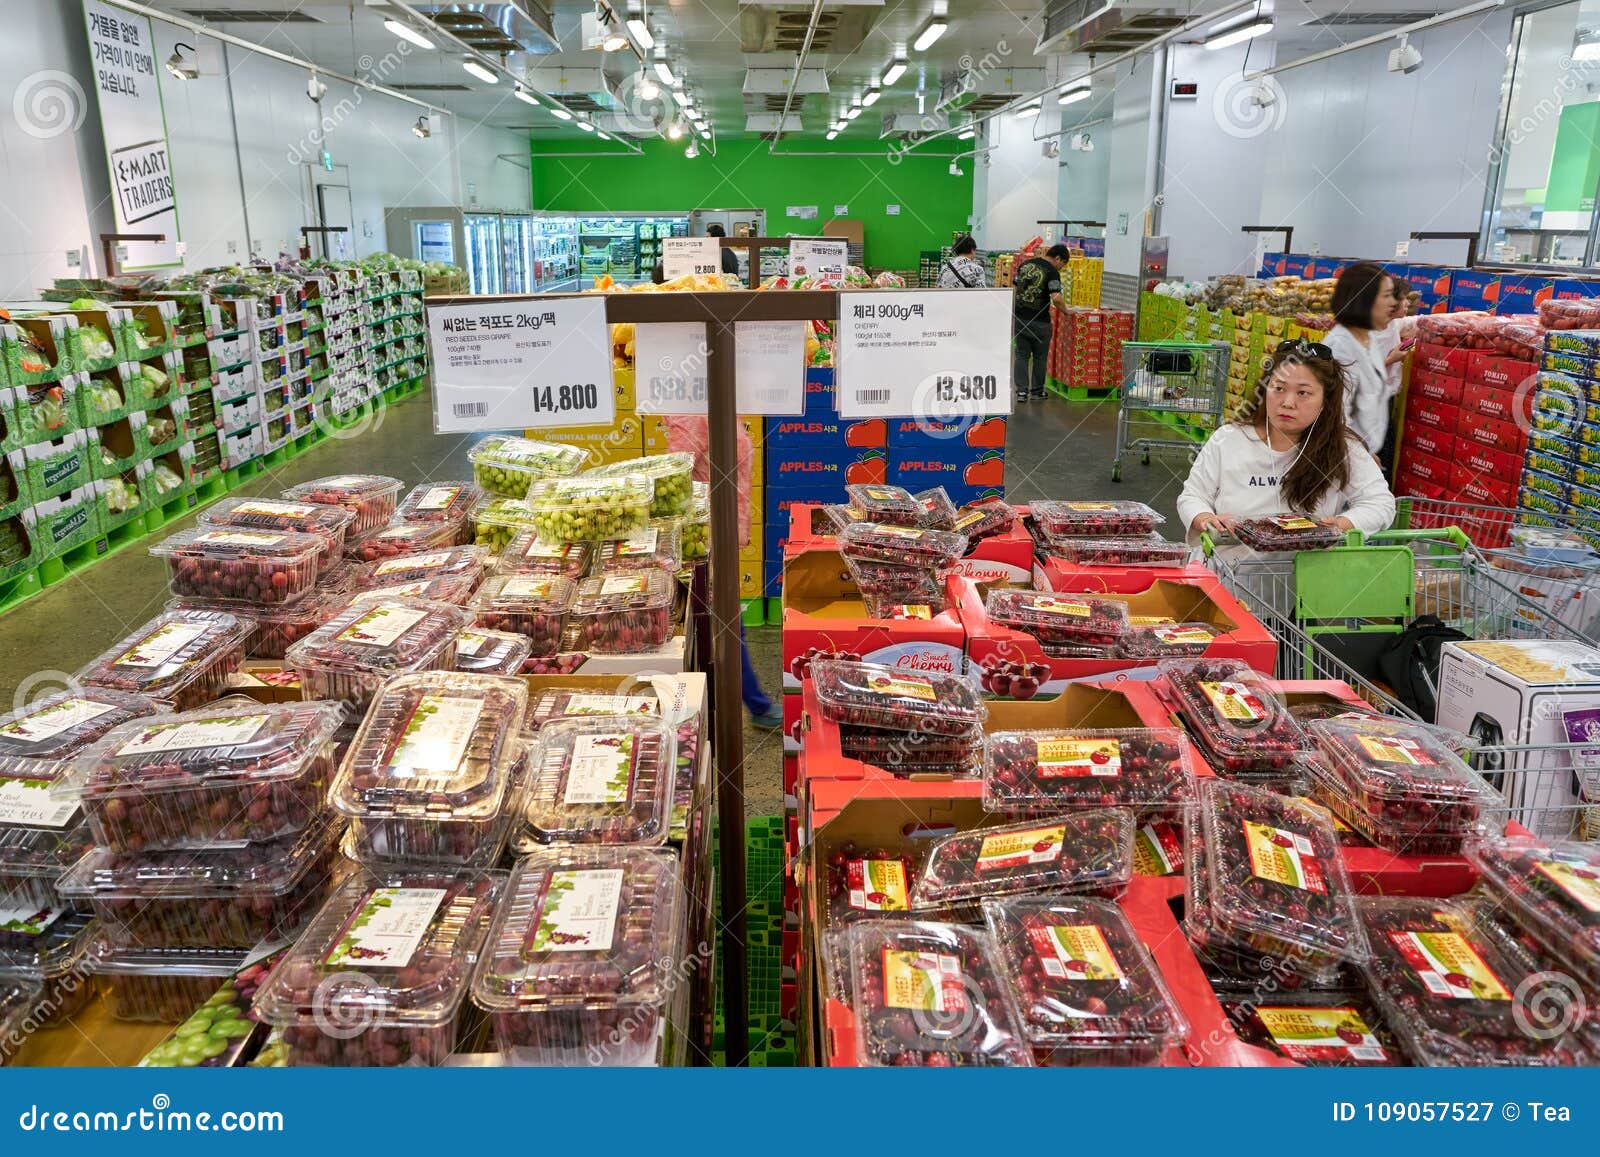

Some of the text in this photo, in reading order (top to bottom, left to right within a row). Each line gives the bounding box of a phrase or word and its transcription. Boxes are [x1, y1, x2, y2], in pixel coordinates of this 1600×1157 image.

[89, 12, 120, 41] 거품을
[94, 41, 154, 76] 가격이 이 안에
[99, 70, 139, 97] 있습니다.
[124, 176, 174, 211] TRADERS
[853, 303, 924, 320] 체리 900g/팩
[443, 312, 556, 332] 씨없는 적포도 2kg/팩
[491, 333, 512, 341] GRAPE
[1483, 370, 1508, 381] TOMATO
[936, 375, 997, 403] 13,980
[533, 383, 598, 413] 14,800
[1479, 399, 1504, 411] TOMATO
[778, 423, 823, 433] APPLES
[900, 421, 943, 432] APPLES
[1474, 428, 1498, 441] TOMATO
[779, 462, 823, 472] APPLES
[898, 461, 942, 472] APPLES
[1470, 455, 1494, 468] TOMATO
[1465, 483, 1489, 496] TOMATO
[921, 650, 949, 661] Sweet
[896, 653, 955, 673] Cherry
[1042, 743, 1080, 751] SWEET
[1042, 750, 1088, 758] CHERRY
[988, 837, 1024, 846] SWEET
[986, 843, 1030, 853] CHERRY
[895, 975, 910, 1004] SWEET
[1267, 1013, 1314, 1024] SWEET
[1272, 1024, 1330, 1035] CHERRY
